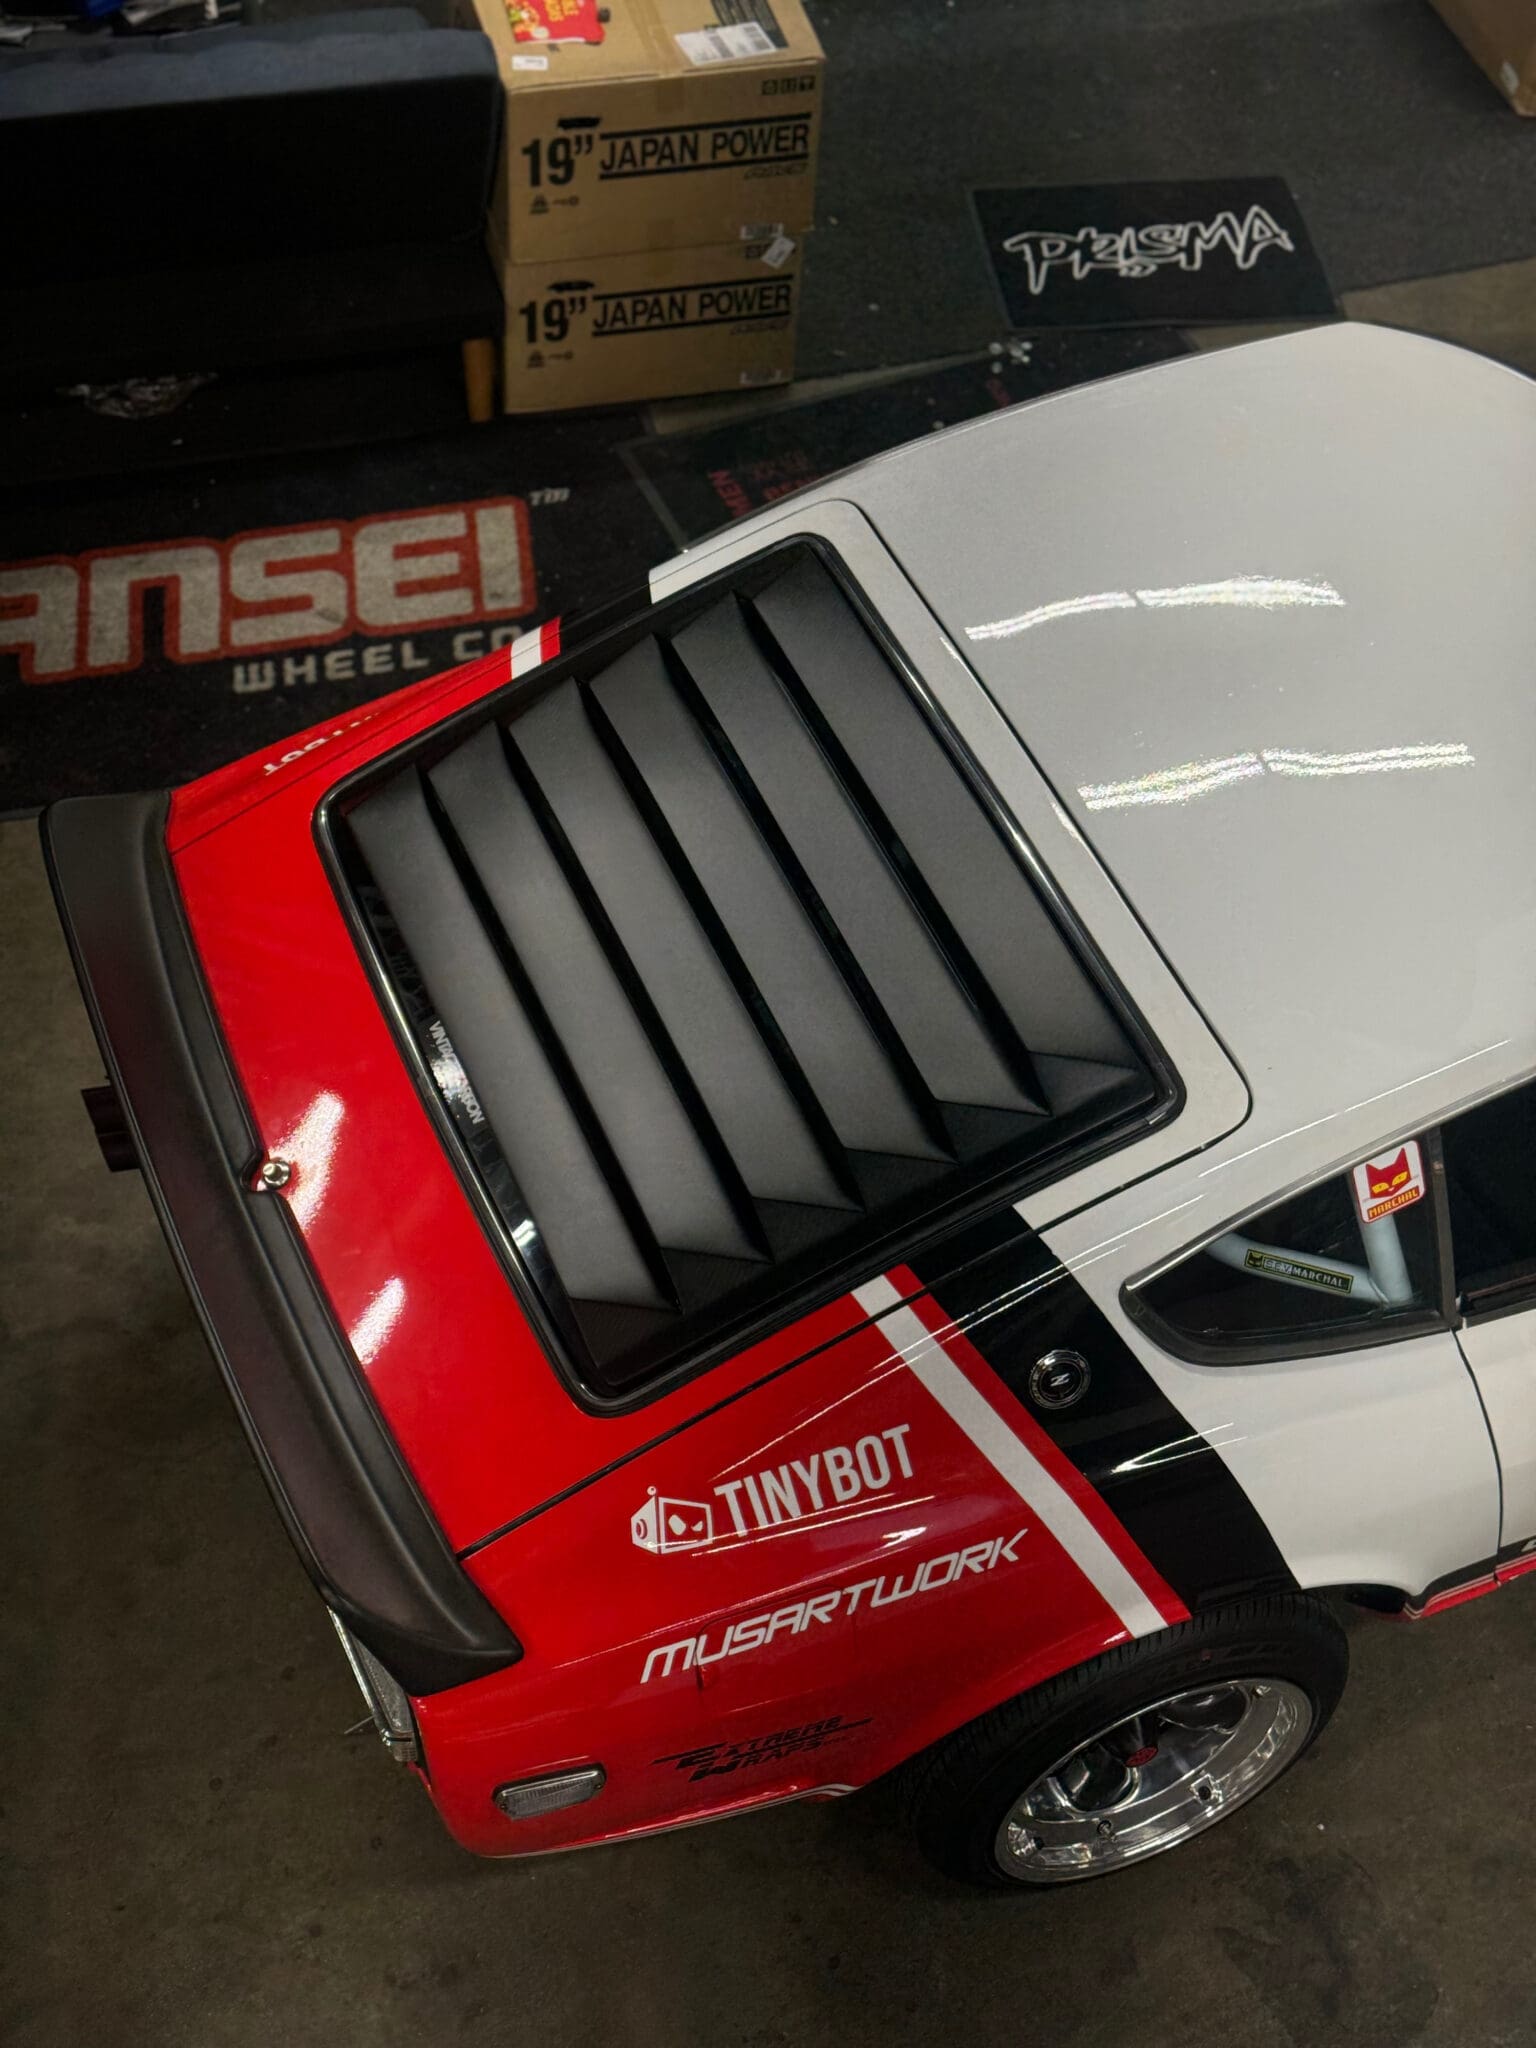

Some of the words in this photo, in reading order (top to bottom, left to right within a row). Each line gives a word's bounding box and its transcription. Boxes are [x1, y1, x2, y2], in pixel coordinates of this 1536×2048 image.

[600, 133, 699, 171] JAPAN
[711, 123, 809, 160] POWER
[592, 293, 686, 329] JAPAN
[699, 284, 792, 317] POWER
[233, 643, 429, 695] WHEEL
[429, 1021, 462, 1073] VINTA
[1367, 1187, 1420, 1221] MARCHAL
[1292, 1264, 1344, 1288] MARCHAL
[713, 1423, 913, 1538] TINYBOT
[640, 1528, 1029, 1684] MUSARTWORK
